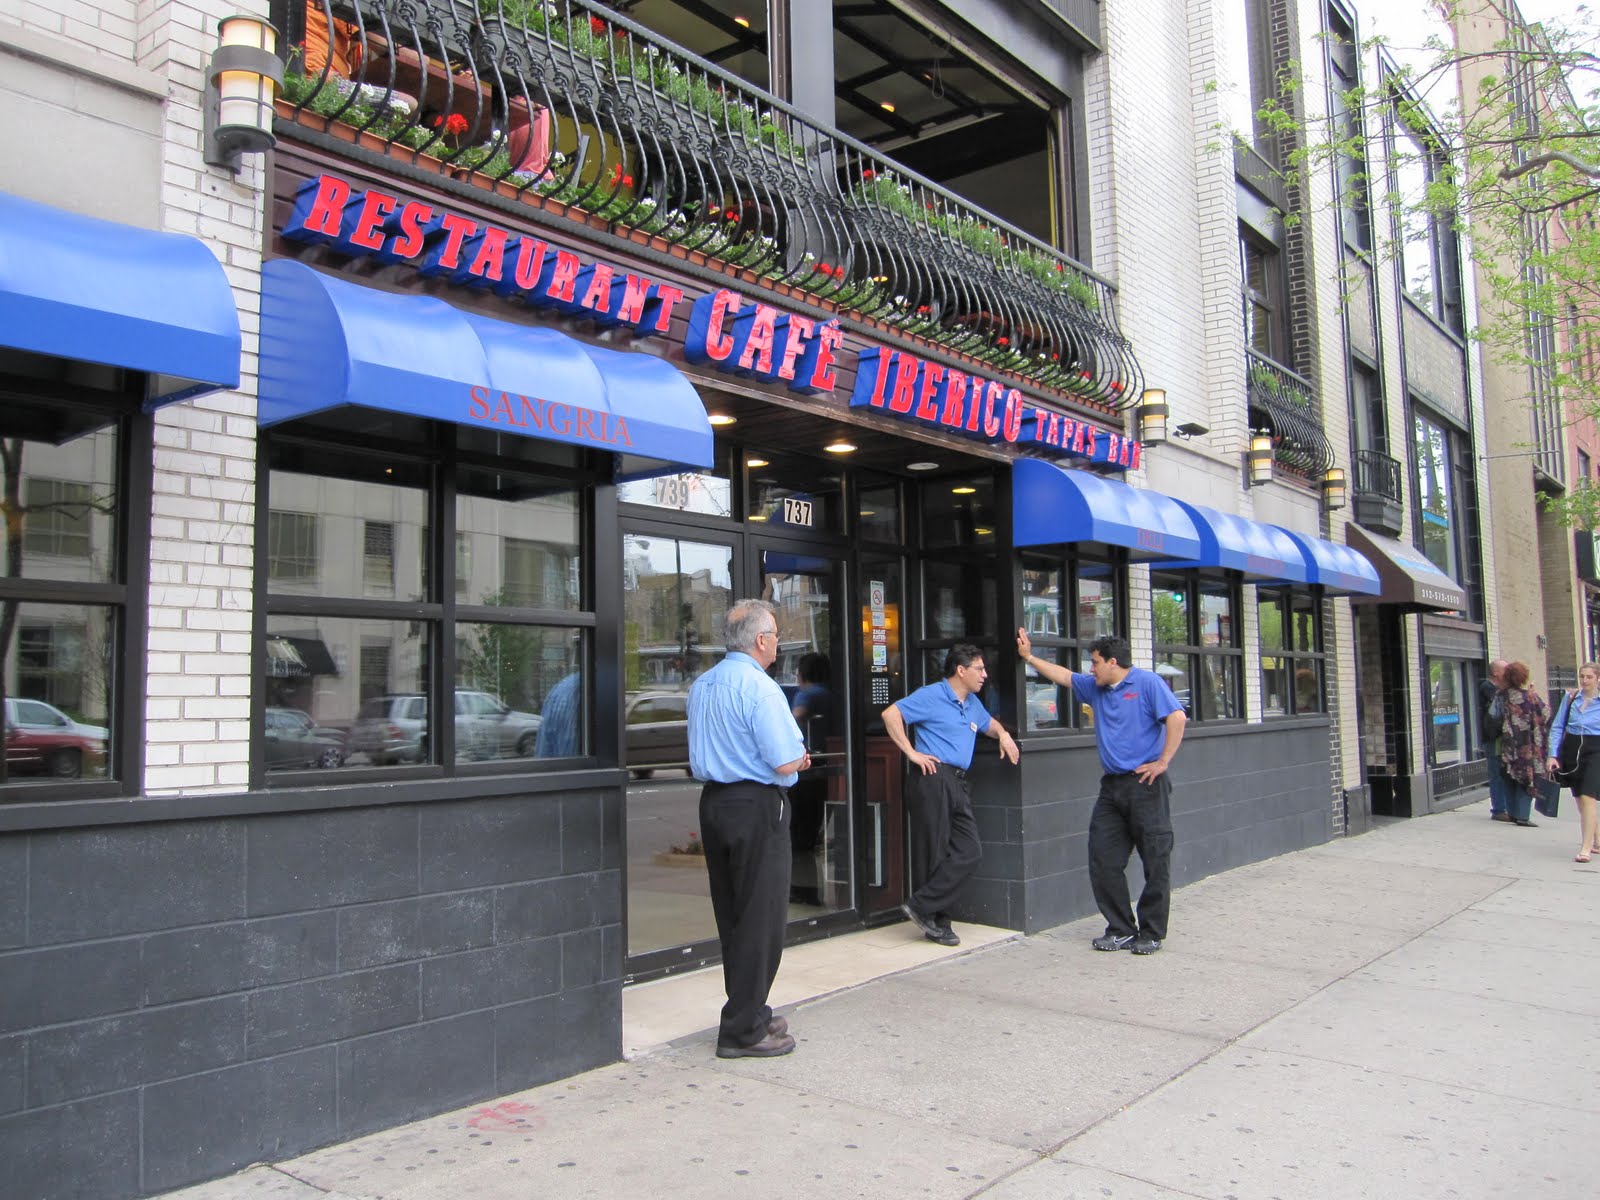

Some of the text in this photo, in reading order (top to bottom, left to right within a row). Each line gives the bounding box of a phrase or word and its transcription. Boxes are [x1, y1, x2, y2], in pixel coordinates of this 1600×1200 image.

[303, 173, 1141, 470] RESTAURANT CAFÉ IBERICO TAPAS BAR
[468, 385, 634, 447] SANGRIA
[657, 478, 690, 507] 739
[786, 499, 811, 525] 737
